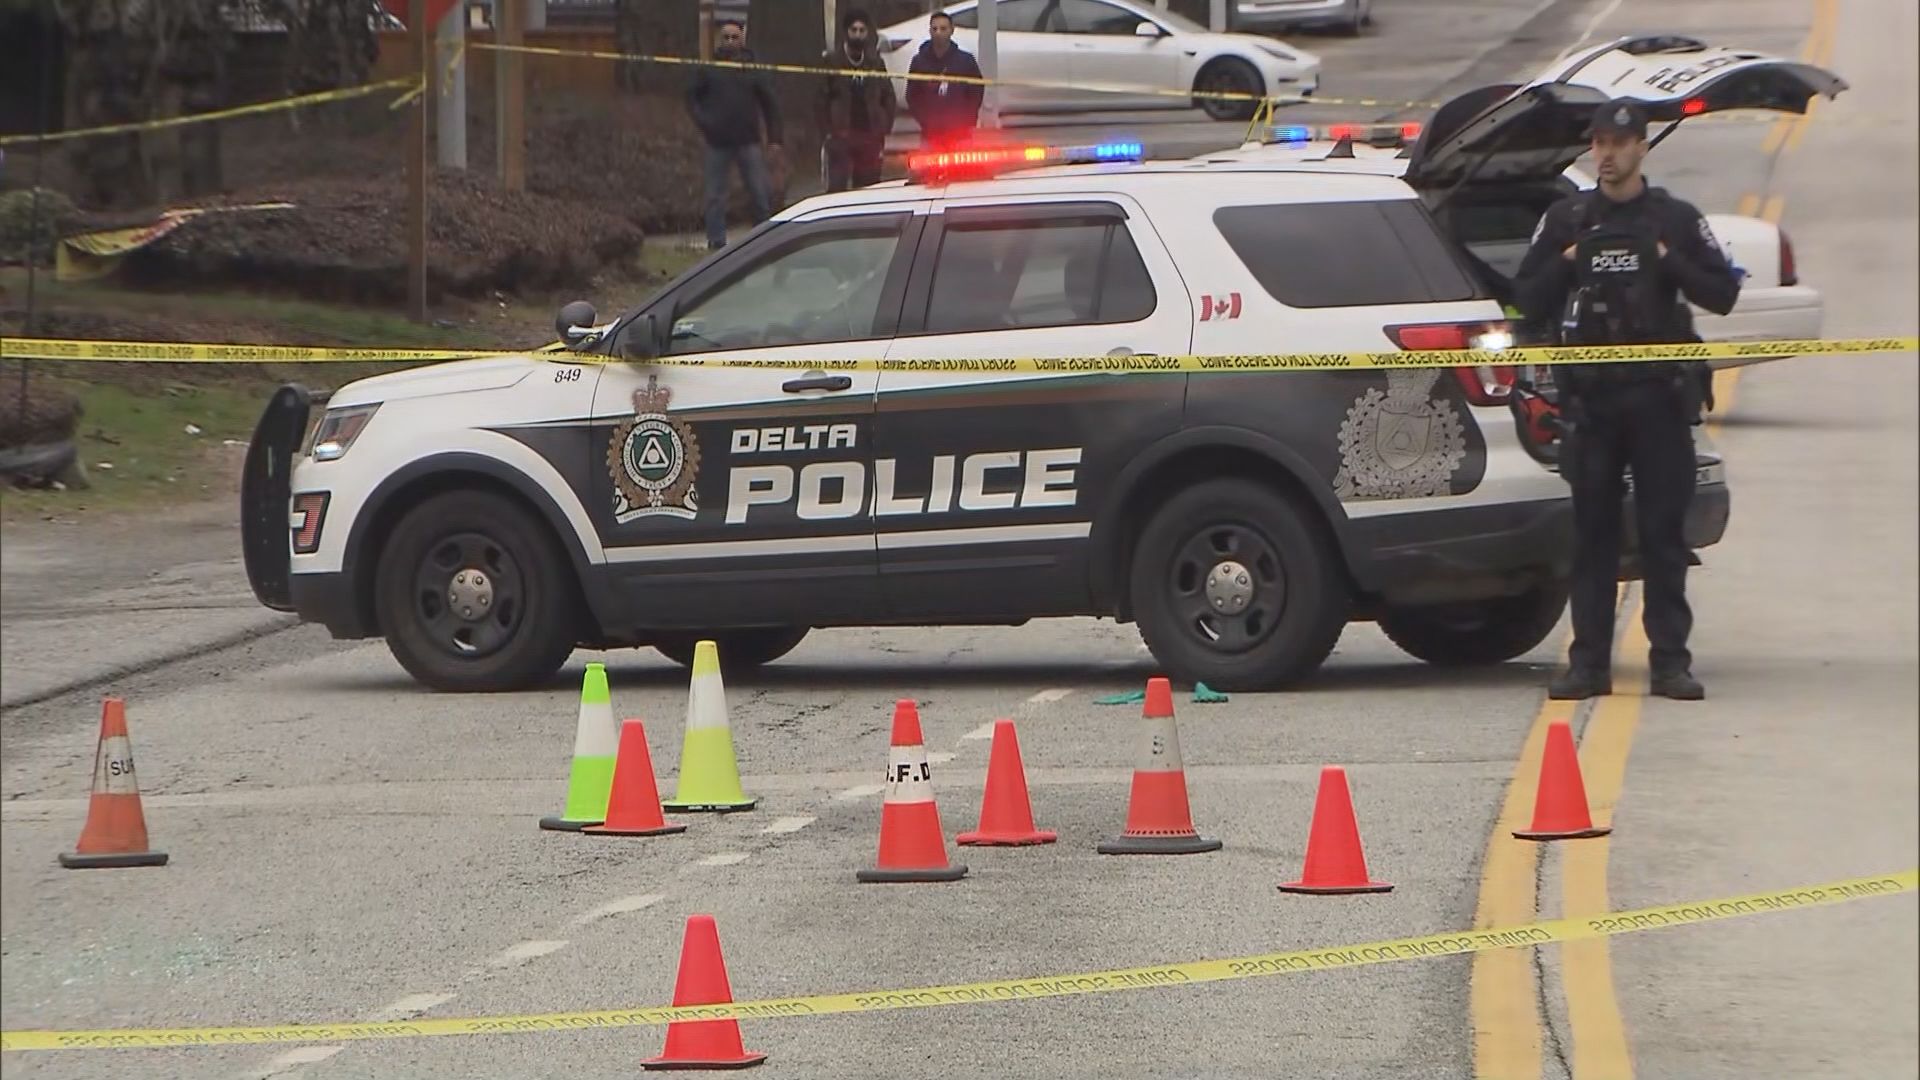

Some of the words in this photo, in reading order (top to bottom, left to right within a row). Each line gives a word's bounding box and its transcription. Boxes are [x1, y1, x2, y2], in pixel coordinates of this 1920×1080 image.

[1592, 254, 1640, 268] POLICE
[554, 368, 582, 384] 849
[730, 424, 857, 453] DELTA
[725, 447, 1083, 525] POLICE
